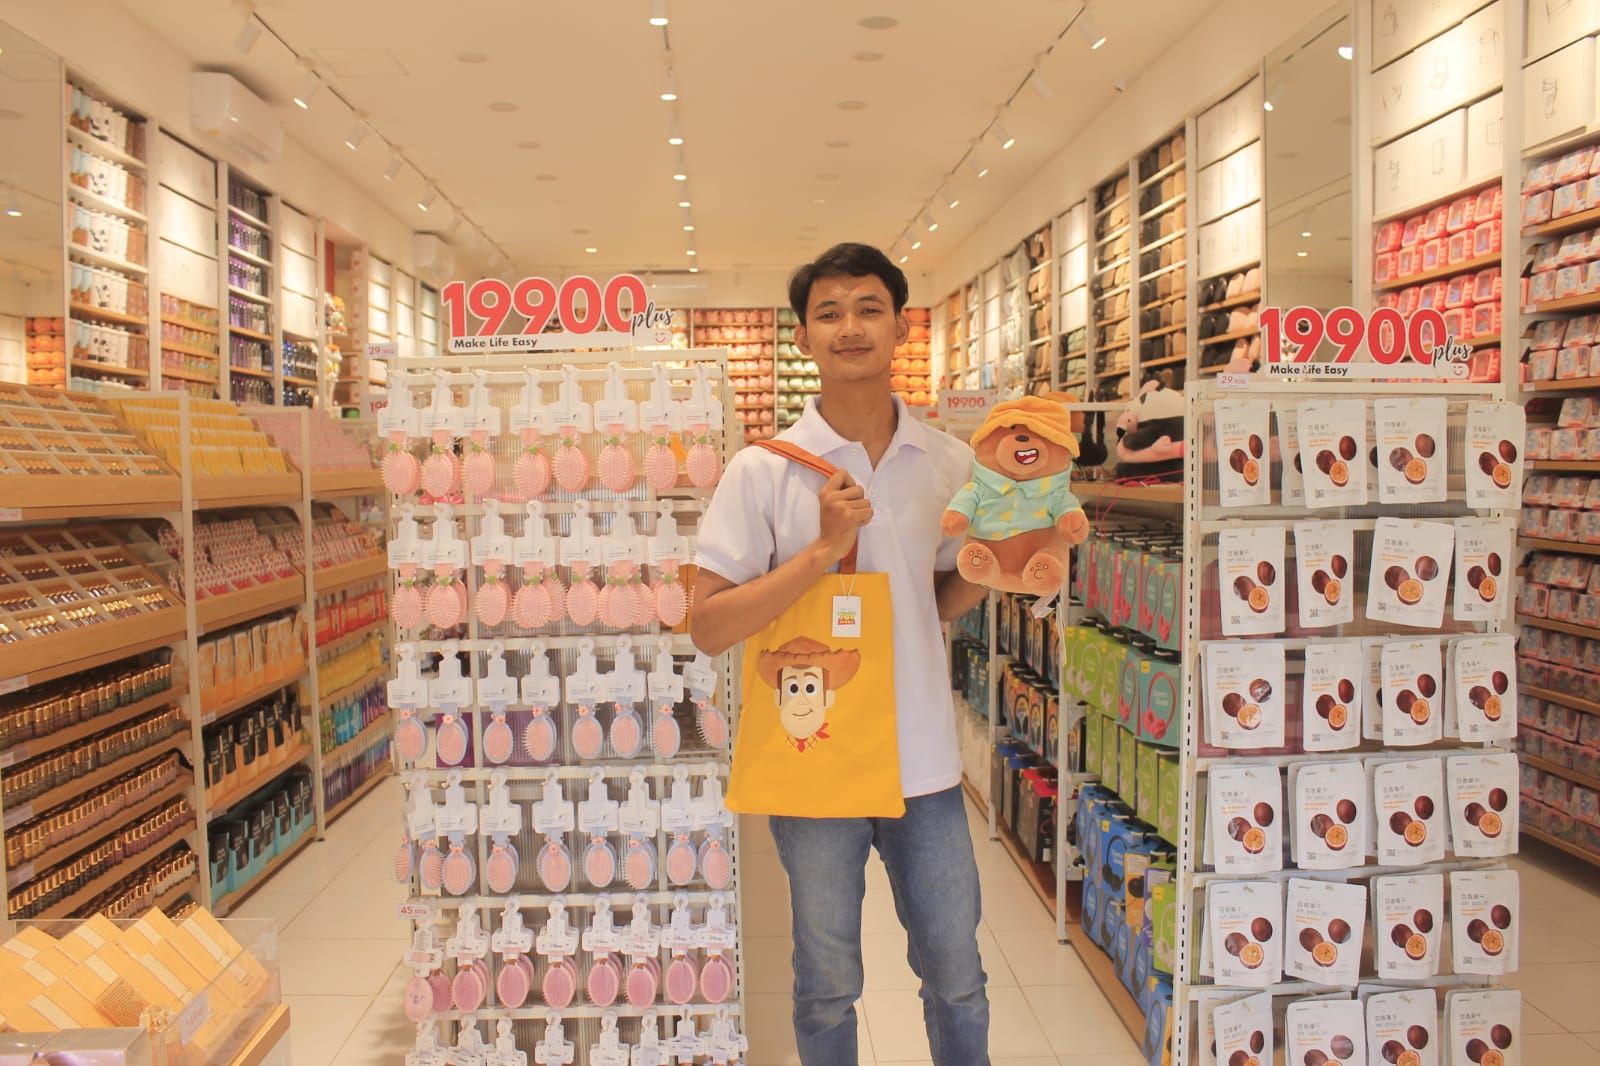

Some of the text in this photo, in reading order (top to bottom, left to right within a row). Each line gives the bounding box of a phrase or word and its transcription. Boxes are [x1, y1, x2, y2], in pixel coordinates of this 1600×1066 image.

[442, 274, 675, 337] 19900 plus
[454, 337, 538, 349] Make Life Easy
[1259, 307, 1472, 369] 19900 plus
[1270, 364, 1301, 375] Make
[1324, 364, 1349, 377] Easy
[946, 396, 986, 409] 19900
